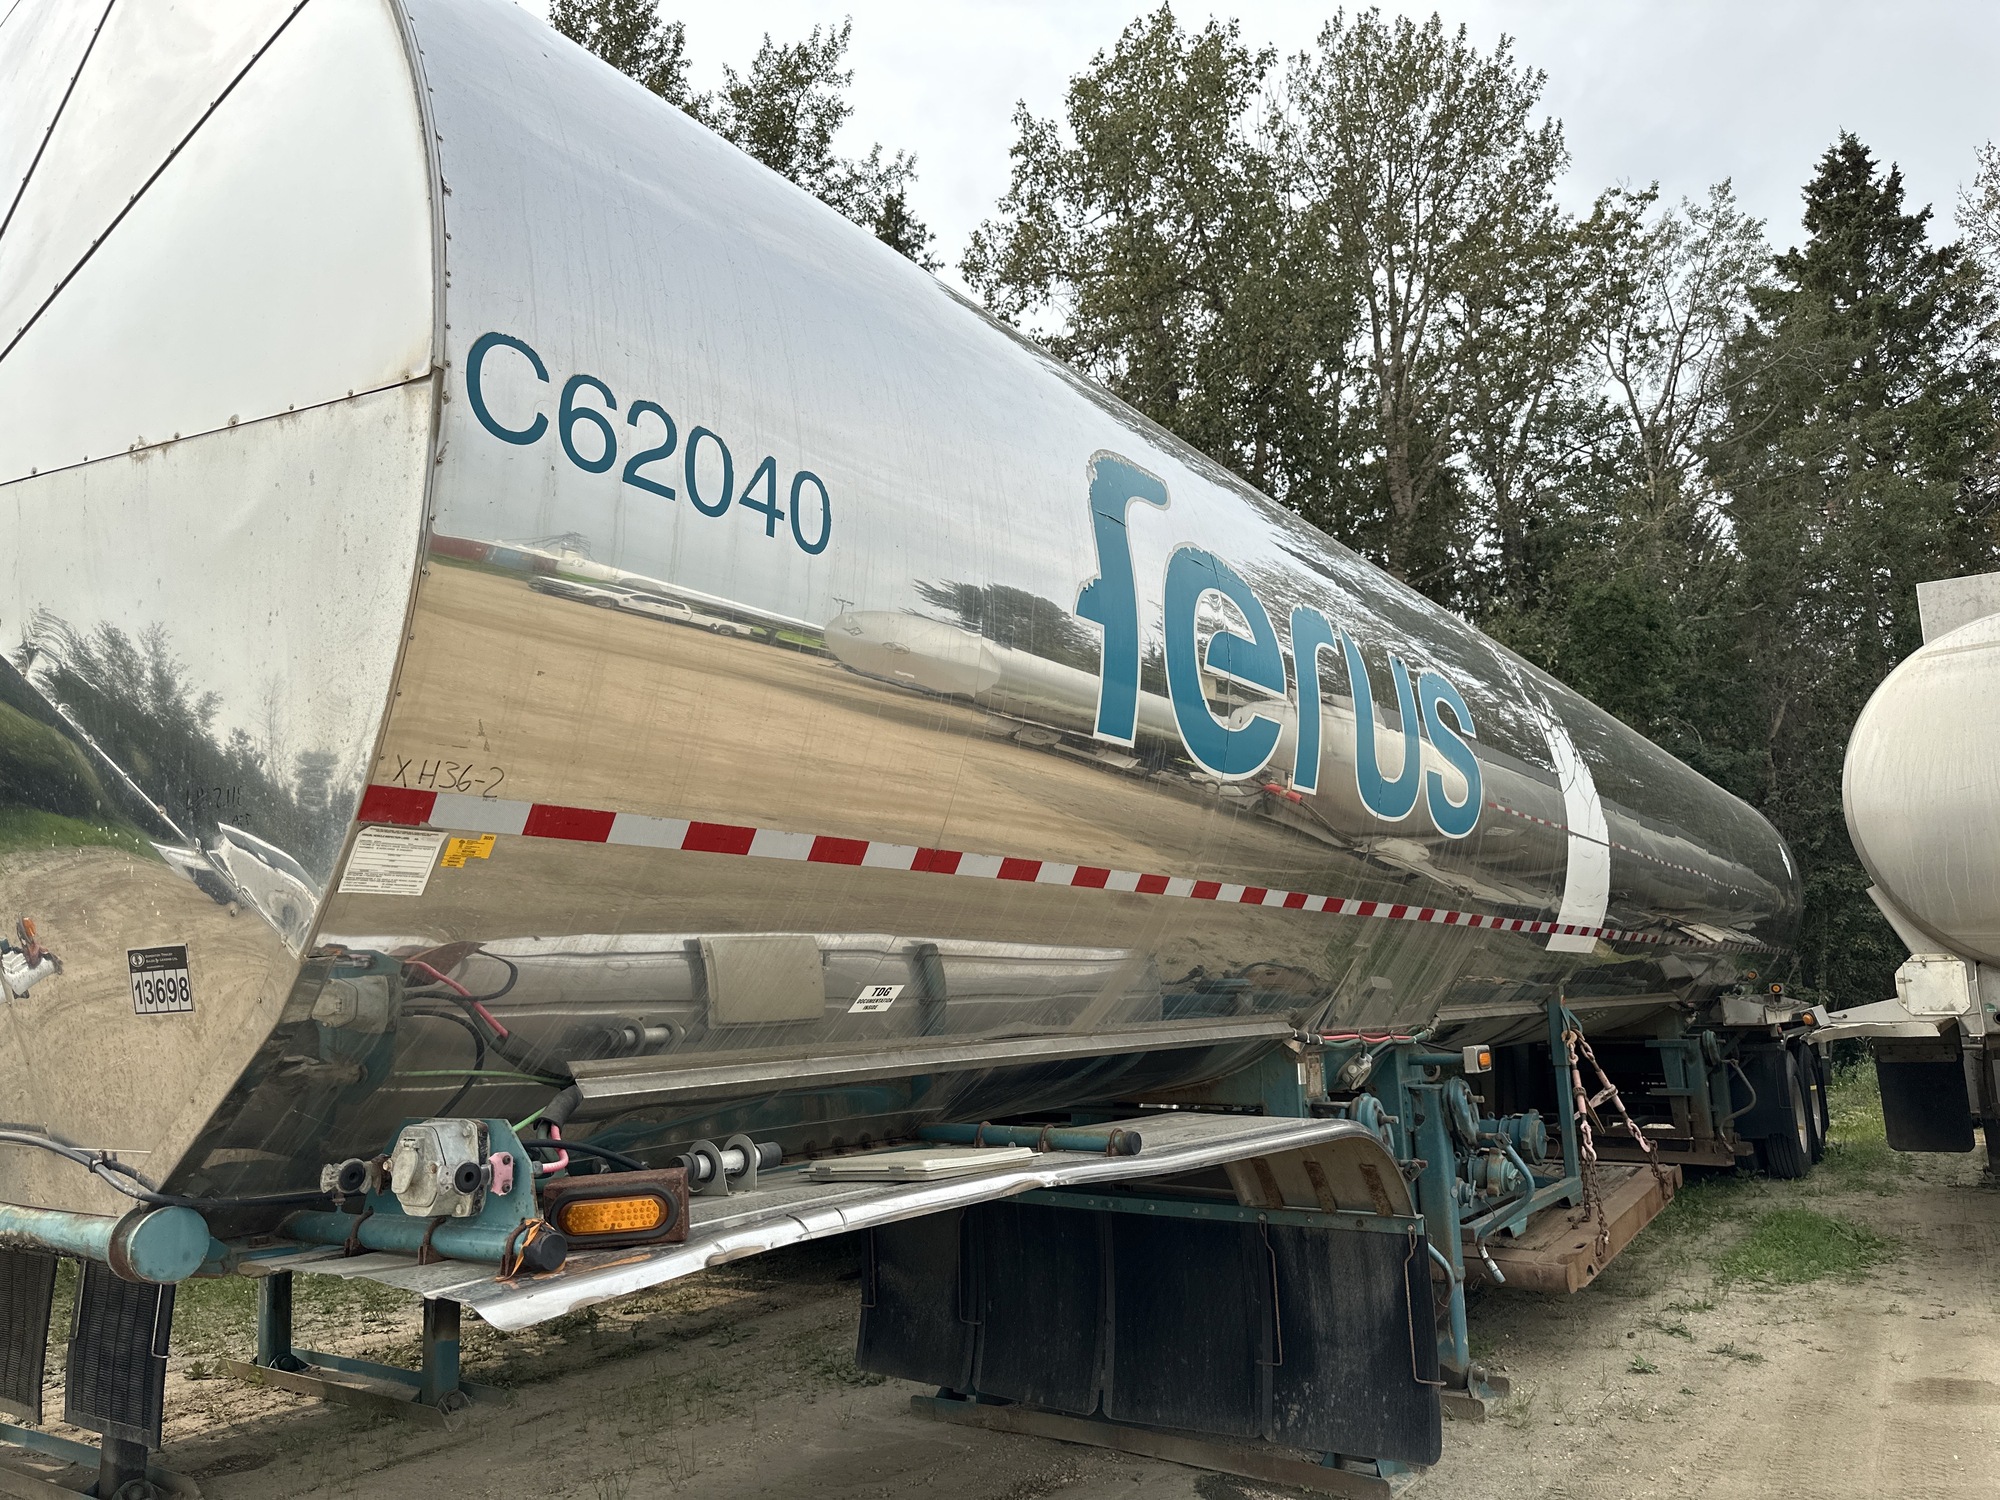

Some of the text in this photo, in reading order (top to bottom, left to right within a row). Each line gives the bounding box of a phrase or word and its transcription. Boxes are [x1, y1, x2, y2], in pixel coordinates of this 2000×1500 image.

[466, 332, 831, 555] C62040
[1073, 449, 1483, 839] ferus
[134, 976, 190, 1005] 13698
[872, 987, 892, 997] TDG
